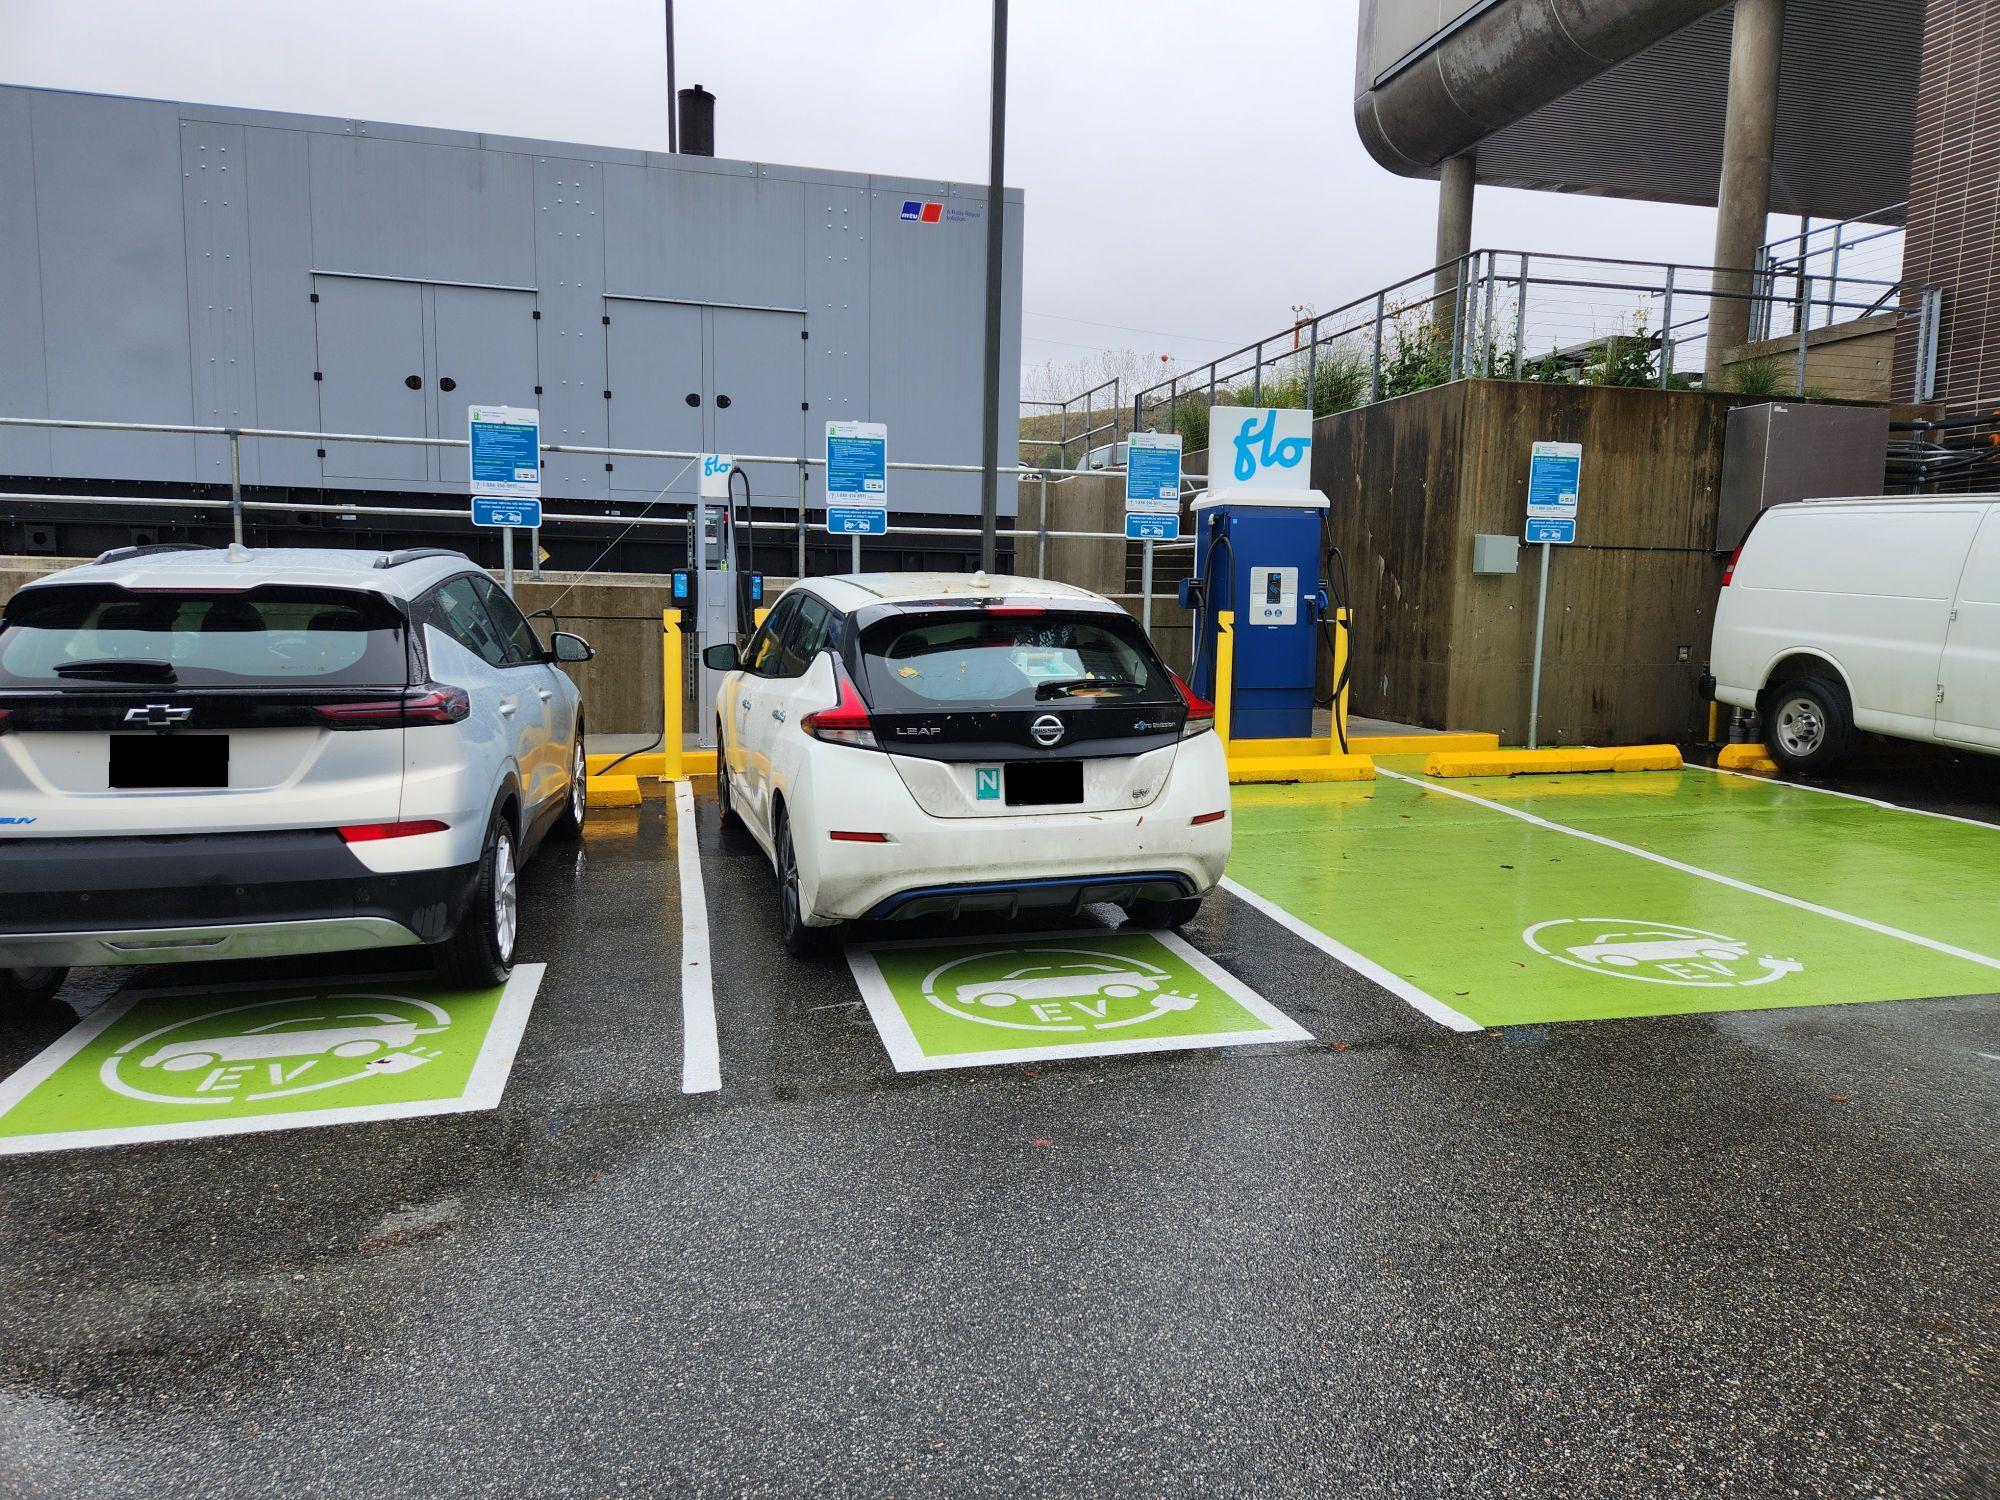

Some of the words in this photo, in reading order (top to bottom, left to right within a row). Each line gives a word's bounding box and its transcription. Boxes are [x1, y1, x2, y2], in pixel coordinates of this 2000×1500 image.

[1233, 409, 1312, 482] flo
[704, 454, 731, 477] flo
[896, 727, 941, 736] LEAF
[979, 770, 997, 790] N
[1656, 961, 1737, 979] EV
[1029, 999, 1107, 1022] EV
[197, 1060, 318, 1092] EV
